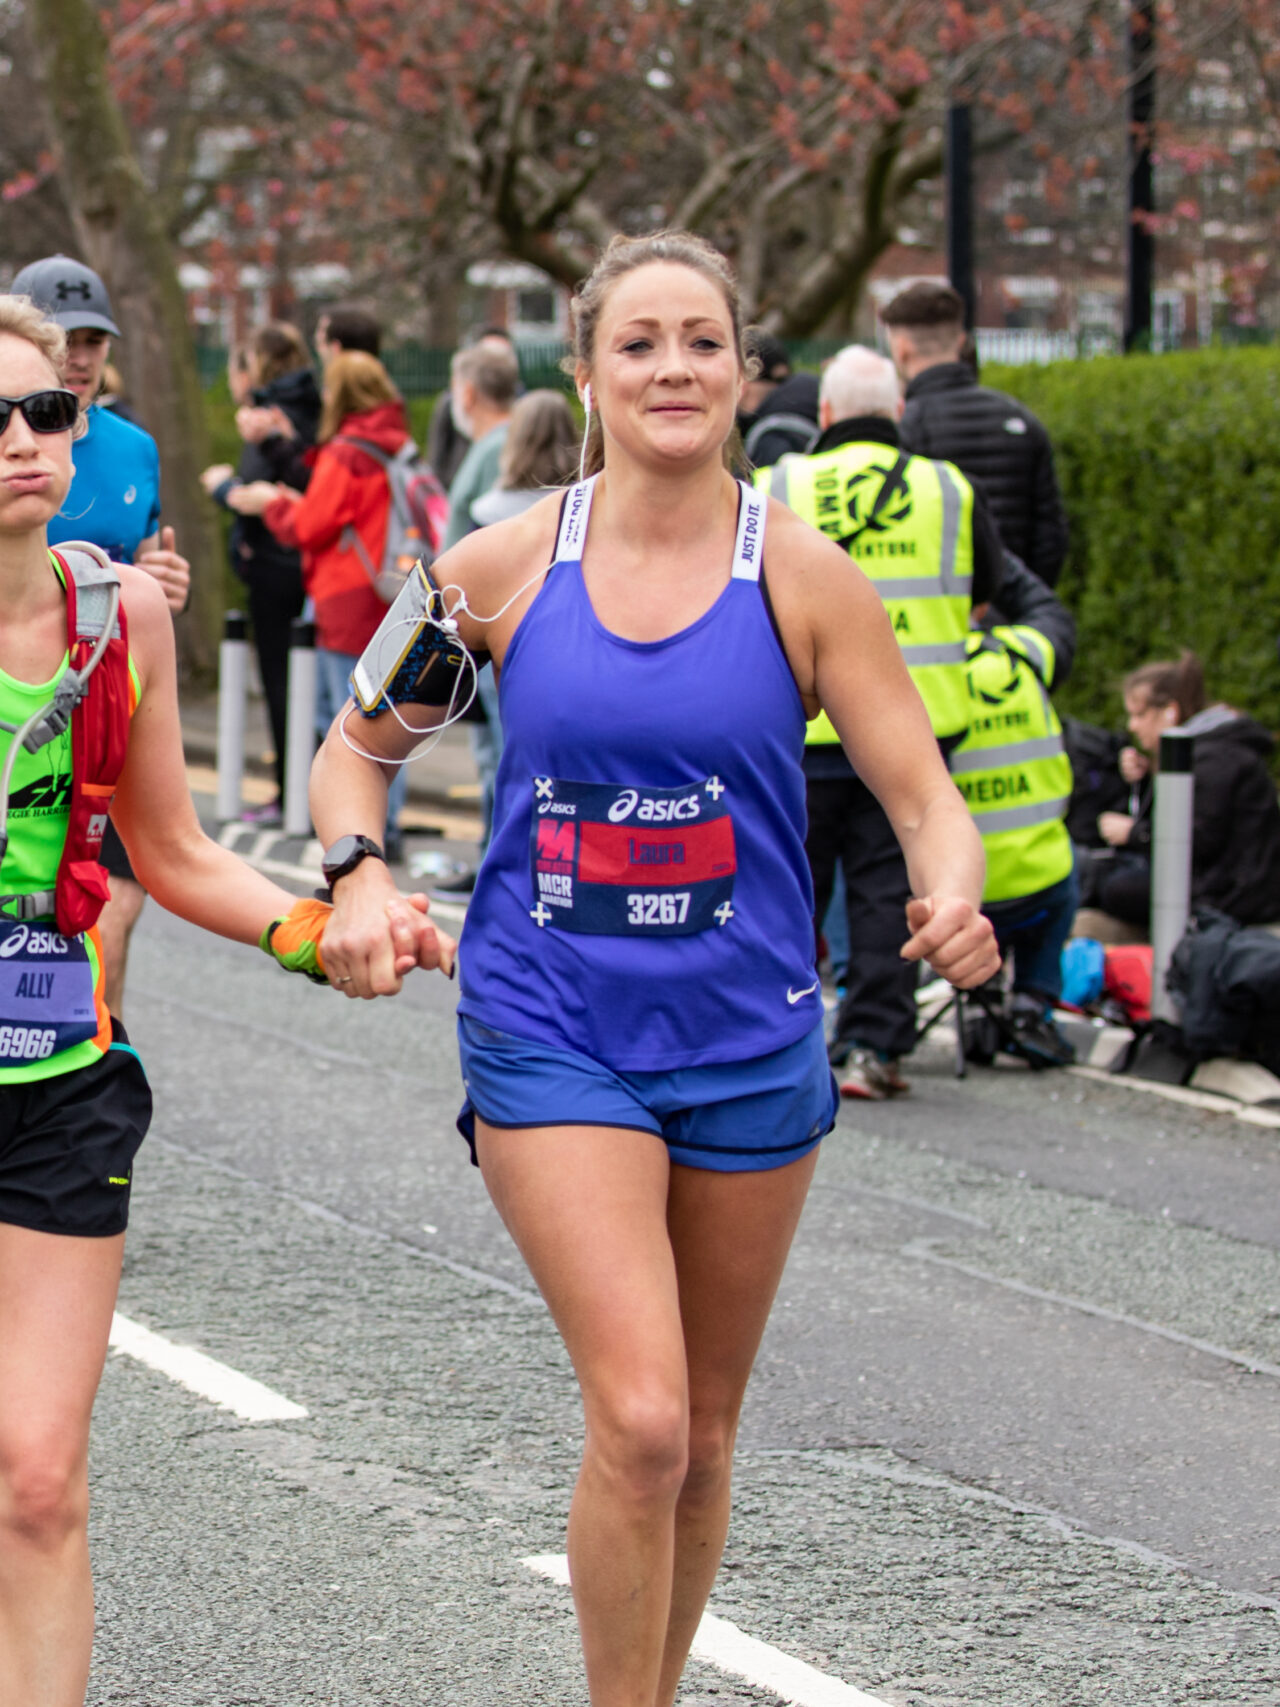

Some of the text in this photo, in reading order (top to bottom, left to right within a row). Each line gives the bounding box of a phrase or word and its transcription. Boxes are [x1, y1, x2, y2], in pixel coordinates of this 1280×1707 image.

[745, 517, 759, 535] DO
[741, 535, 756, 563] JUST
[33, 805, 70, 817] HARRIE
[637, 795, 700, 821] asics
[629, 838, 685, 865] Laura
[537, 873, 572, 897] MCR
[627, 892, 690, 925] 3267
[27, 932, 69, 953] asics
[14, 972, 55, 999] ALLY
